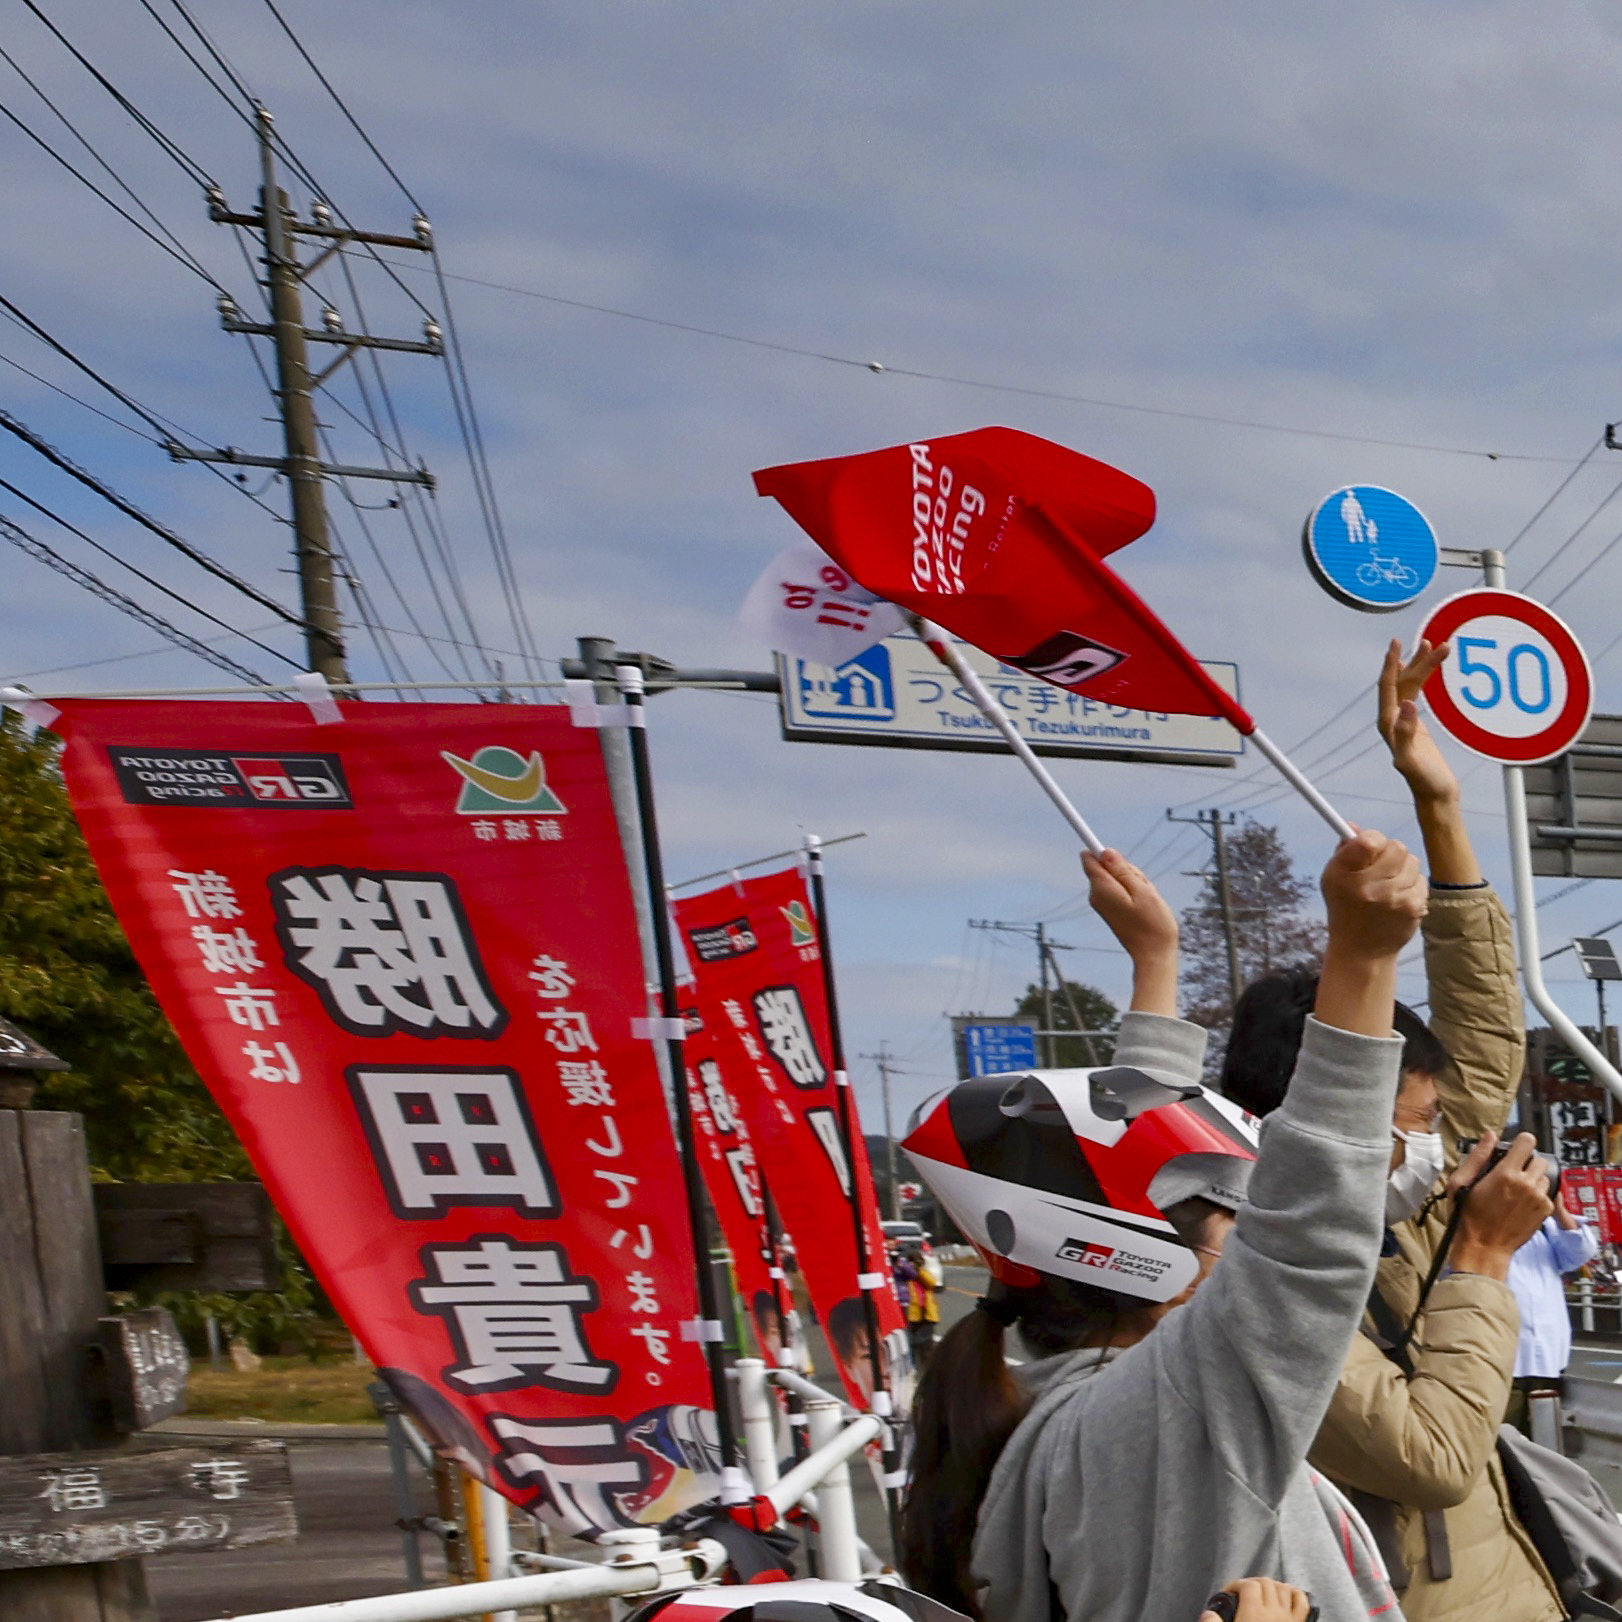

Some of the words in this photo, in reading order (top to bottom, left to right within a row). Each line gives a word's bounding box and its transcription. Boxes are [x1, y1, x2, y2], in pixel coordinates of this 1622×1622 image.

[1458, 636, 1551, 714] 50
[1029, 718, 1151, 741] Tezukurimura
[1057, 1246, 1109, 1268] GR
[1112, 1257, 1164, 1275] GAZOO
[1117, 1250, 1173, 1269] TOYOTA
[1109, 1263, 1159, 1283] Racing
